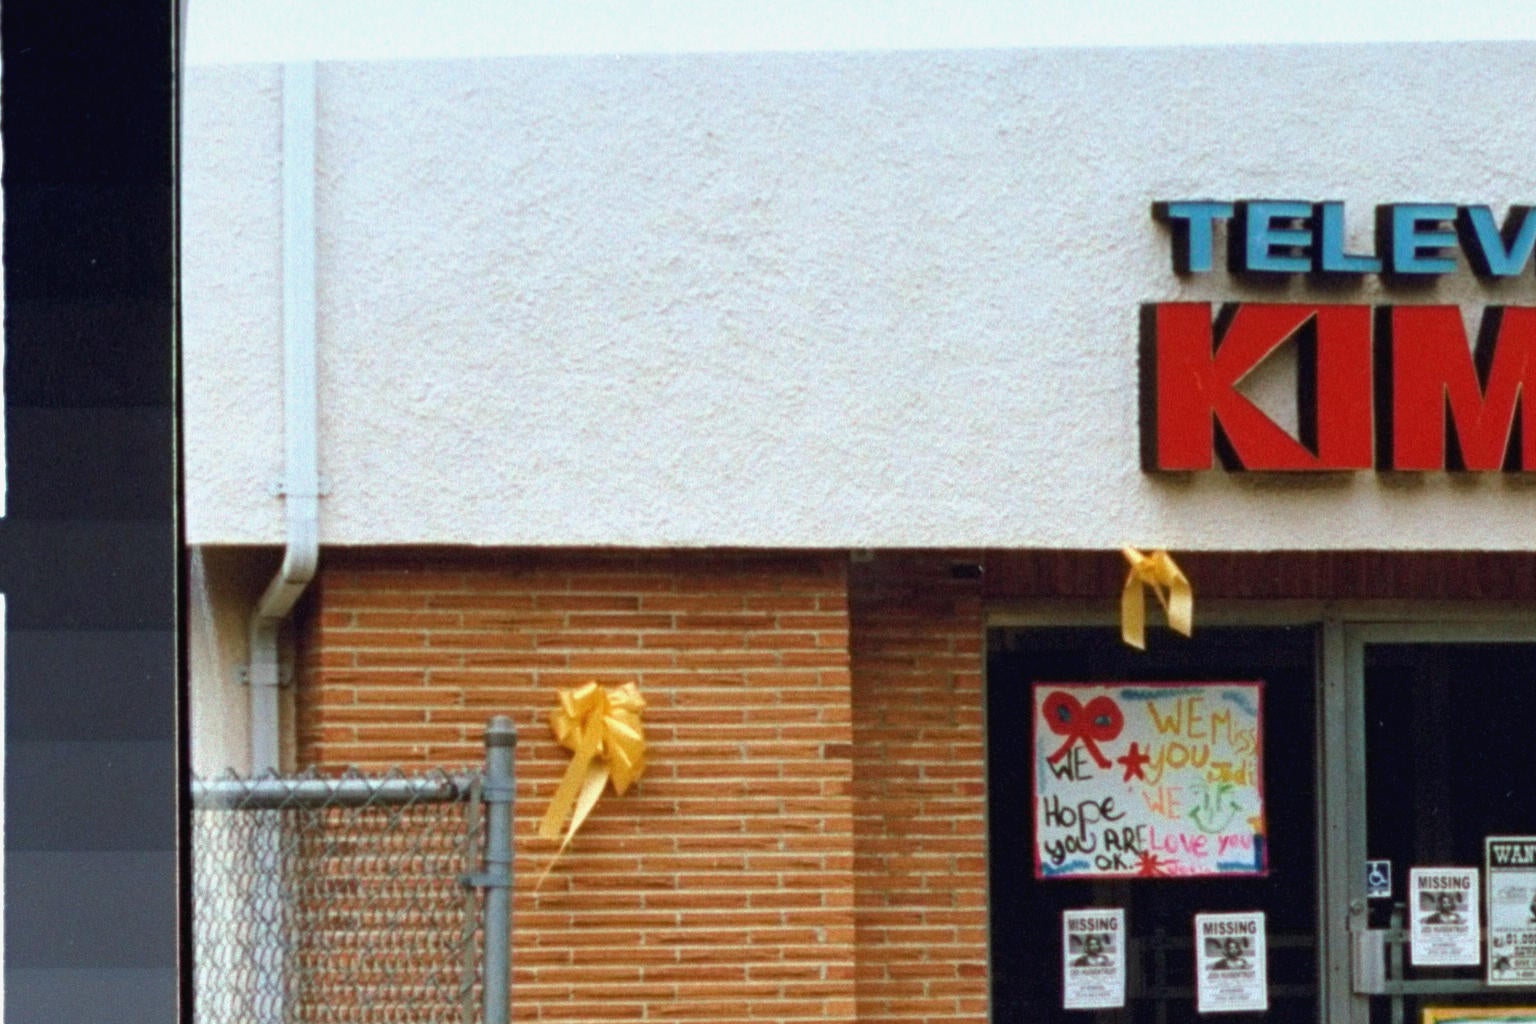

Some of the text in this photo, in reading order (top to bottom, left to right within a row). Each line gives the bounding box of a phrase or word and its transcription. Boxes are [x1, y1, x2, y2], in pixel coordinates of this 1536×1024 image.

[1146, 696, 1207, 739] WE
[1046, 746, 1093, 782] WE
[1417, 876, 1471, 890] MISSING
[1067, 917, 1118, 932] MISSING
[1202, 920, 1257, 936] MISSING
